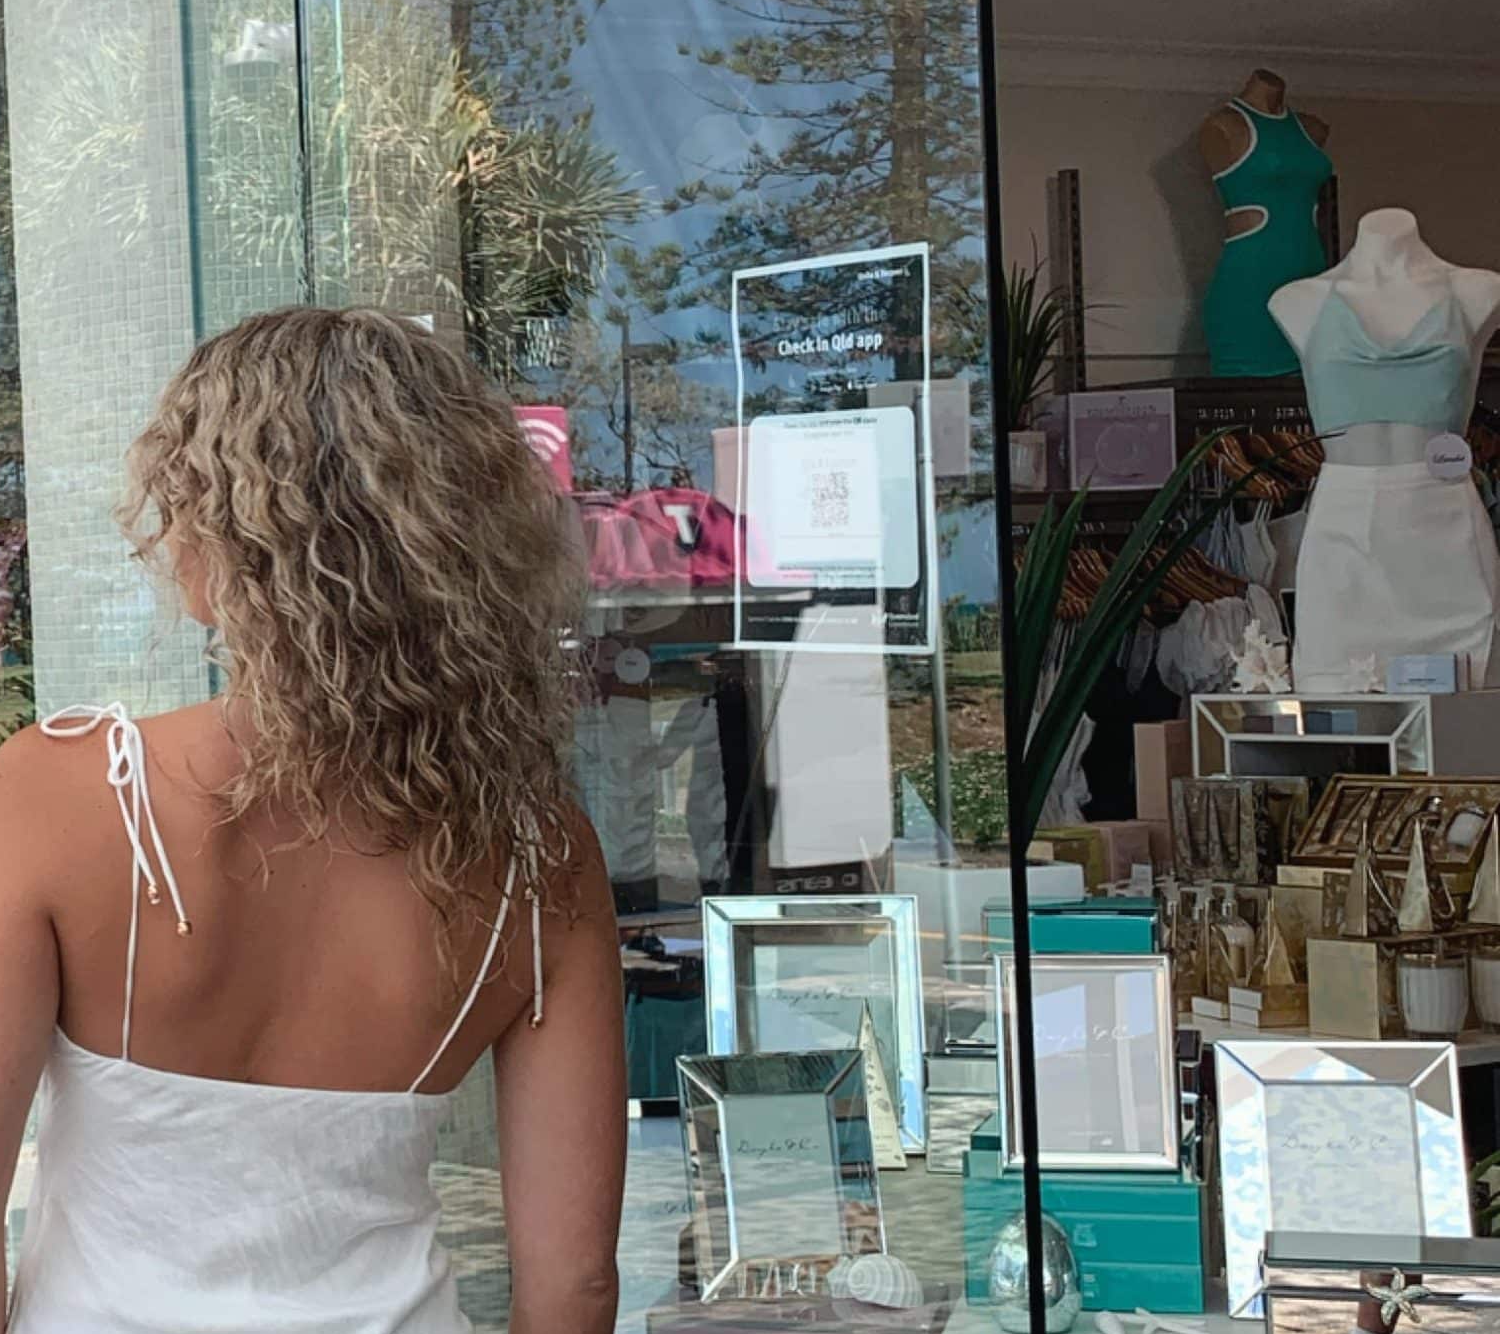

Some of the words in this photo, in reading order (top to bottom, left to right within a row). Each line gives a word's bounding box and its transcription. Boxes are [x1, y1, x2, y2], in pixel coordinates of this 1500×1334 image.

[777, 339, 815, 357] Check
[831, 334, 854, 352] Qld
[856, 333, 884, 354] app
